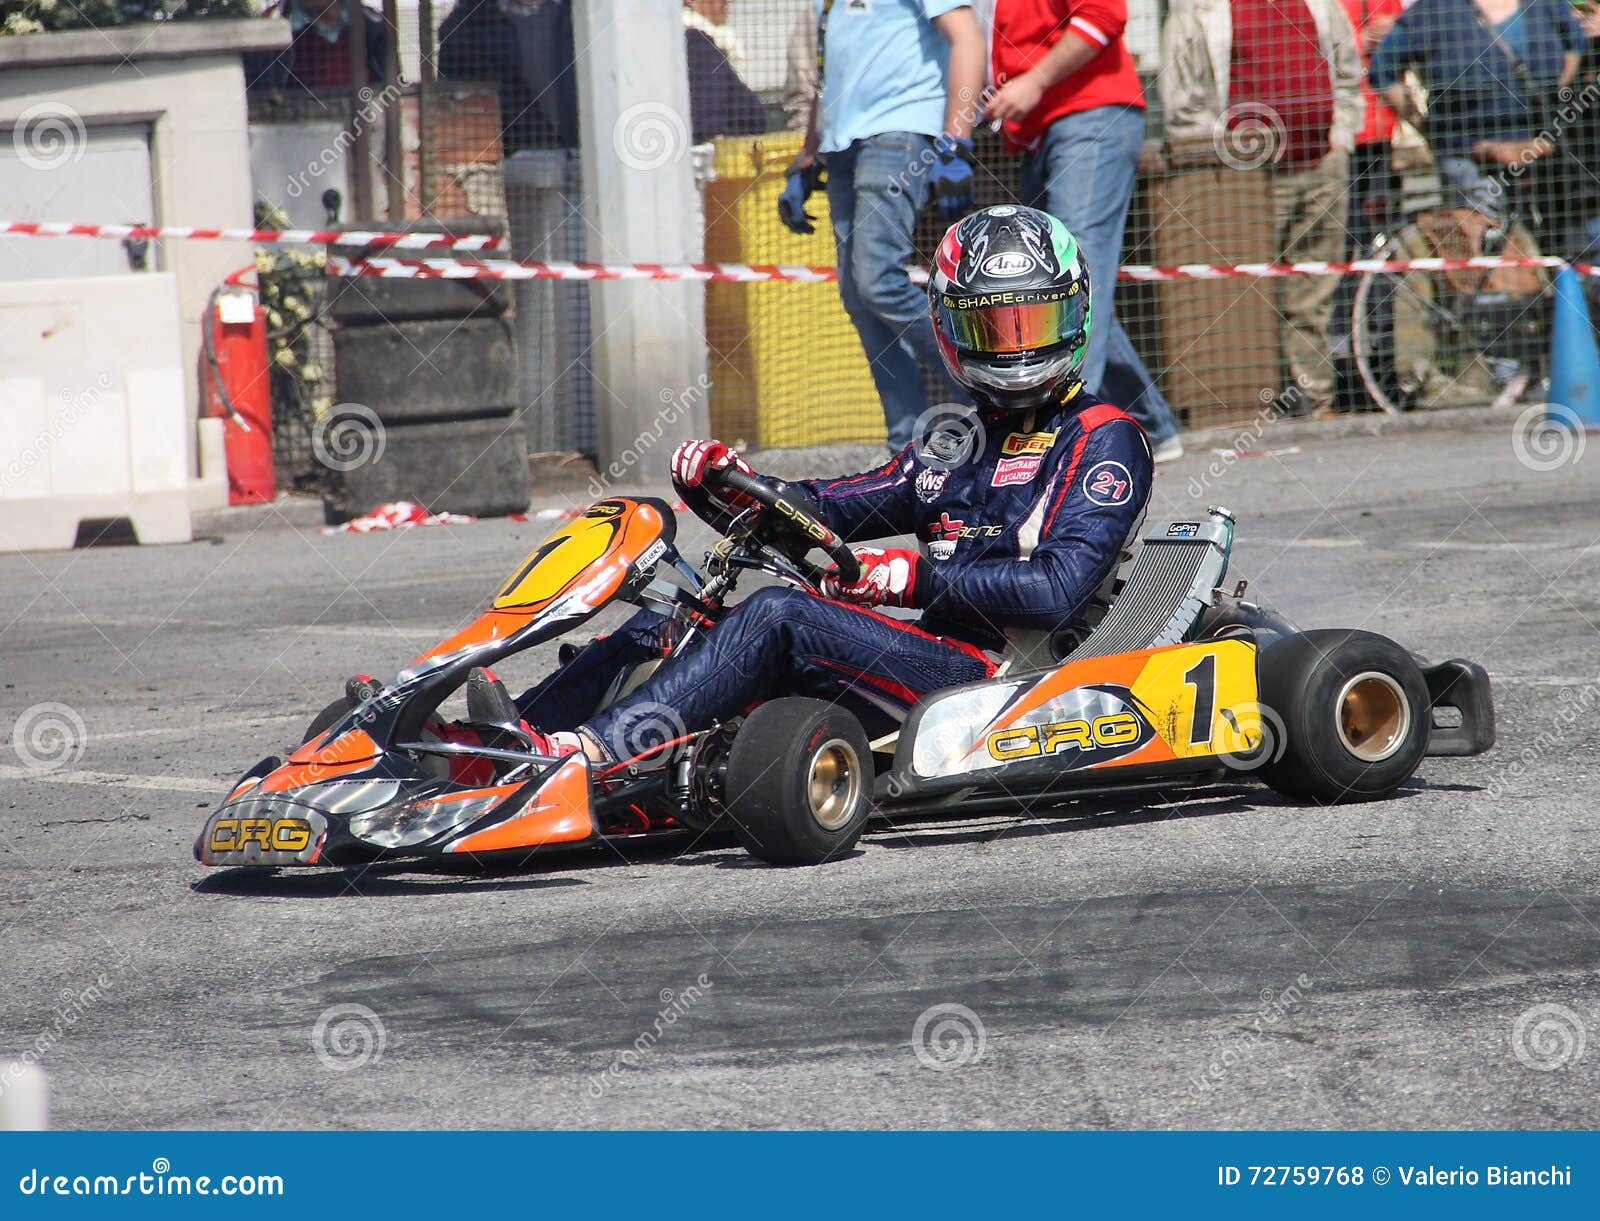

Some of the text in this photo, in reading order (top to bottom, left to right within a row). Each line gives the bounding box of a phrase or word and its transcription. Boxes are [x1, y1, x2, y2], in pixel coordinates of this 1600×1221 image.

[1091, 471, 1127, 500] 21
[1169, 524, 1198, 532] GoPro
[1184, 653, 1217, 746] 1
[988, 711, 1142, 761] CRG
[209, 816, 312, 852] CRG
